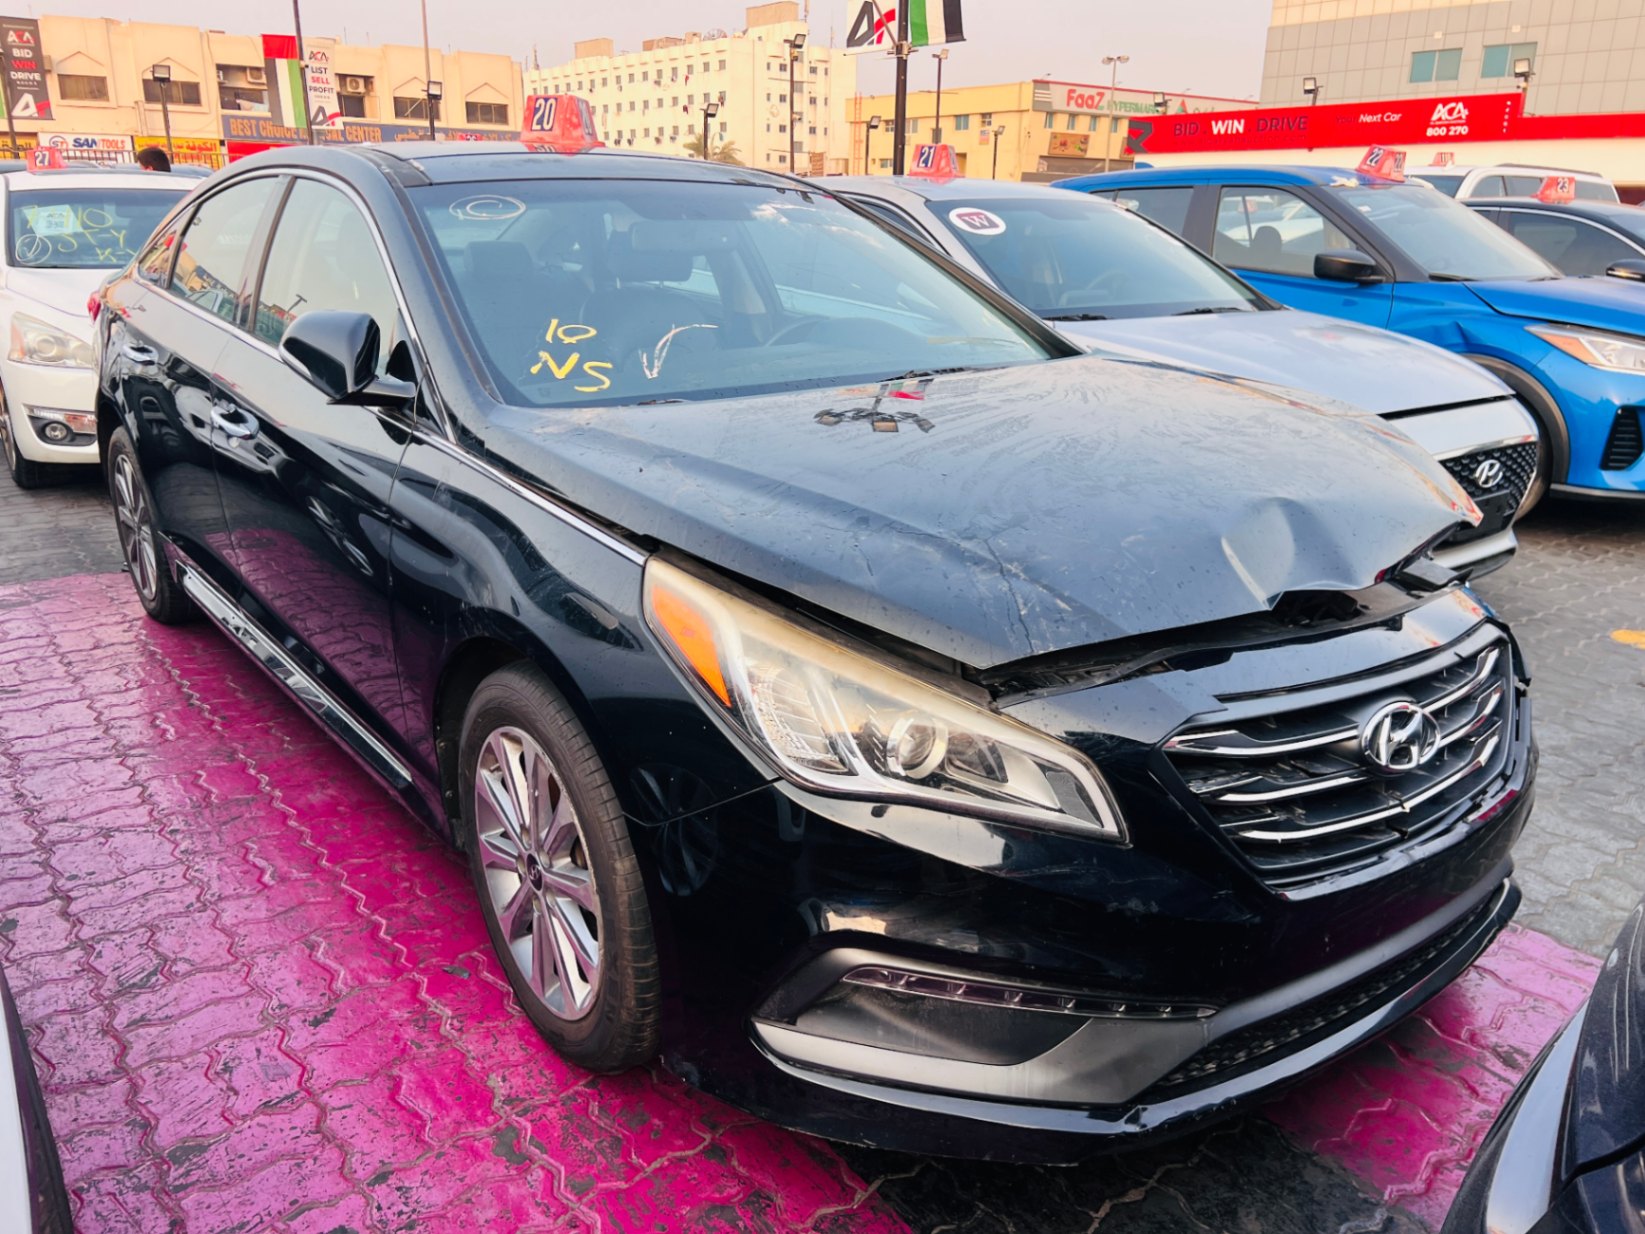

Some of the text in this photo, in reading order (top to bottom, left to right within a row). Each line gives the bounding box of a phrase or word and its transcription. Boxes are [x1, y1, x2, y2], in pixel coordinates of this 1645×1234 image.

[7, 30, 35, 44] ACA
[12, 48, 33, 58] BID
[11, 60, 37, 70] WIN
[311, 66, 328, 74] LIST
[10, 71, 41, 81] DRIVE
[311, 76, 330, 84] SELL
[309, 85, 334, 94] PROFIT
[532, 98, 557, 131] 20
[1359, 113, 1382, 123] Next
[1383, 111, 1402, 123] Car
[1431, 101, 1469, 121] ACA
[230, 118, 257, 136] BEST
[345, 125, 382, 143] CENTER
[1174, 116, 1308, 136] BID WIN DRIVE
[1426, 125, 1469, 137] 800 270
[100, 138, 126, 149] TOOLS
[34, 150, 50, 167] 27
[919, 146, 936, 168] 21
[1366, 146, 1385, 167] 22
[960, 214, 990, 228] W
